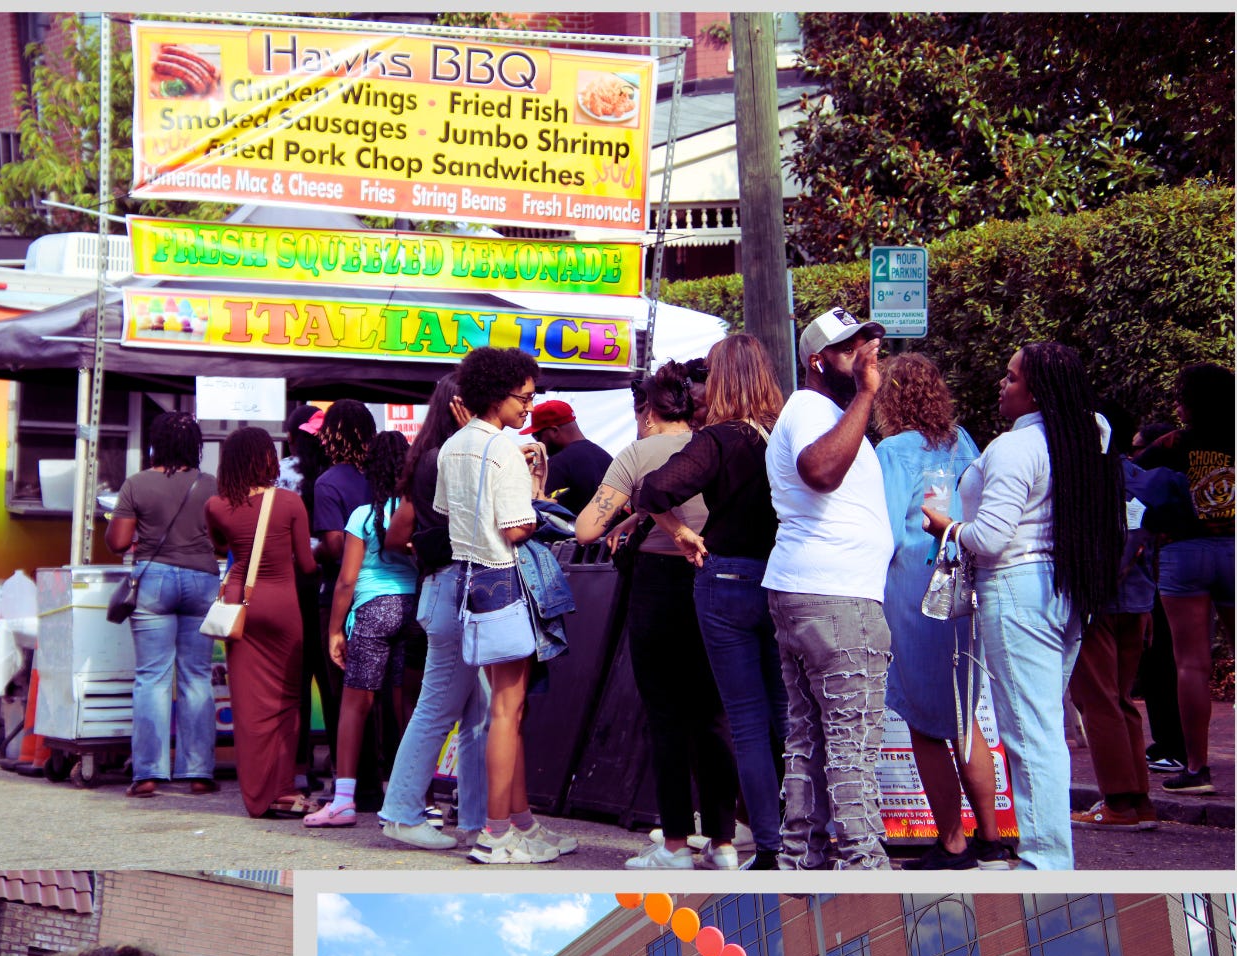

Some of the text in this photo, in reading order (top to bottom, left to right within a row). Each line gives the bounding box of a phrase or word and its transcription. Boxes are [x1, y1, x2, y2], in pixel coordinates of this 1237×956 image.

[263, 34, 537, 90] Hawks BBQ
[231, 78, 568, 124] Chicken Wings Fried Fish
[160, 107, 630, 164] Smoked Sausages Jumbo Shrimp
[205, 137, 585, 187] Fried Pork Chop Sandwiches
[235, 169, 268, 192] Mac
[271, 175, 285, 195] &
[288, 176, 344, 200] Cheese
[360, 179, 396, 204] Fries
[412, 183, 457, 214] String
[461, 188, 507, 212] Beans
[522, 193, 562, 217] Fresh
[565, 196, 641, 224] Lemonade
[151, 225, 622, 284] FRESH SQUEEZED LEMONADE
[875, 254, 887, 277] 2
[896, 253, 917, 265] HOUR
[891, 267, 923, 279] PARKING
[222, 300, 621, 361] ITALIAN ICE
[392, 405, 409, 419] NO
[1188, 450, 1232, 467] CHOOSE
[880, 753, 911, 761] ITEMS
[879, 798, 926, 806] ESSERTS
